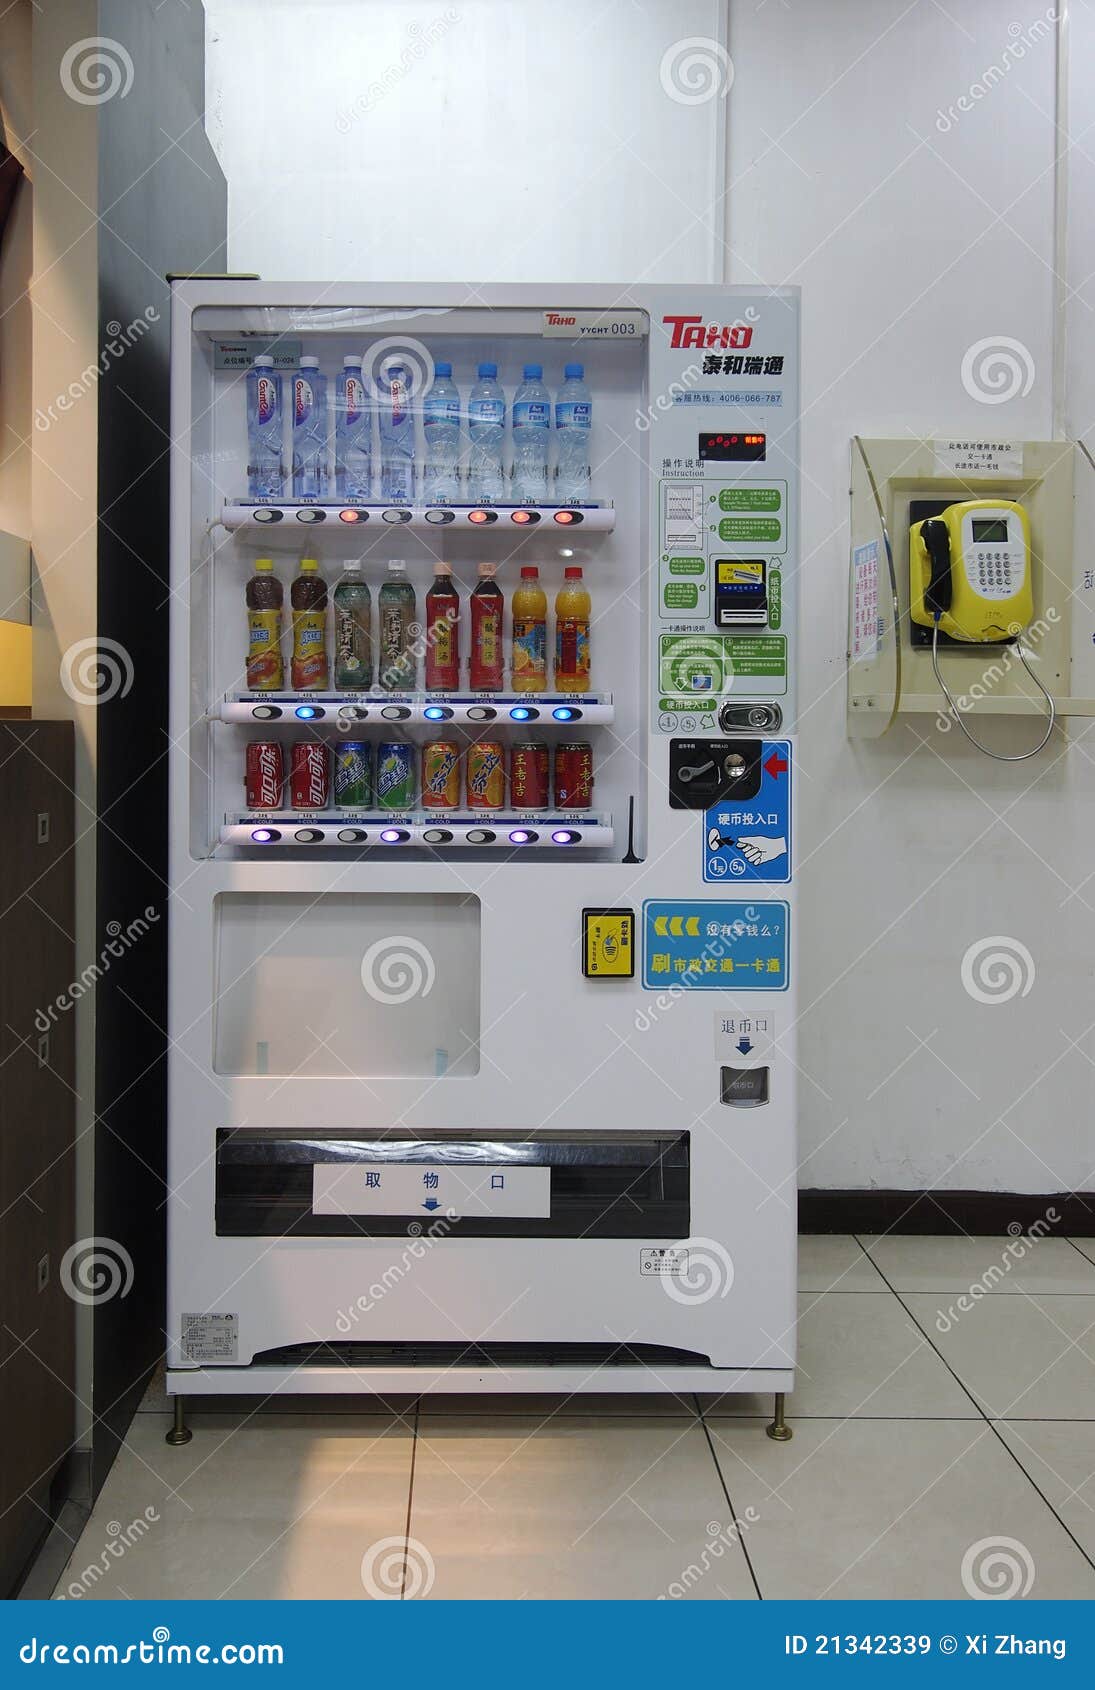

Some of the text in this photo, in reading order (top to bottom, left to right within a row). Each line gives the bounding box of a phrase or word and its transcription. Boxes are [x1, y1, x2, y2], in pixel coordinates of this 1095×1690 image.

[546, 314, 576, 325] TAHO
[612, 323, 635, 334] 003
[663, 316, 753, 348] TAHO
[702, 355, 784, 375] 泰和瑞通
[719, 394, 781, 402] 4006-066-787
[662, 459, 704, 468] 操作说明
[662, 469, 705, 477] Instruction
[515, 753, 527, 797] 王老吉
[580, 753, 591, 797] 王老吉
[718, 813, 778, 825] 硬币投入口
[721, 1019, 767, 1033] 退币口
